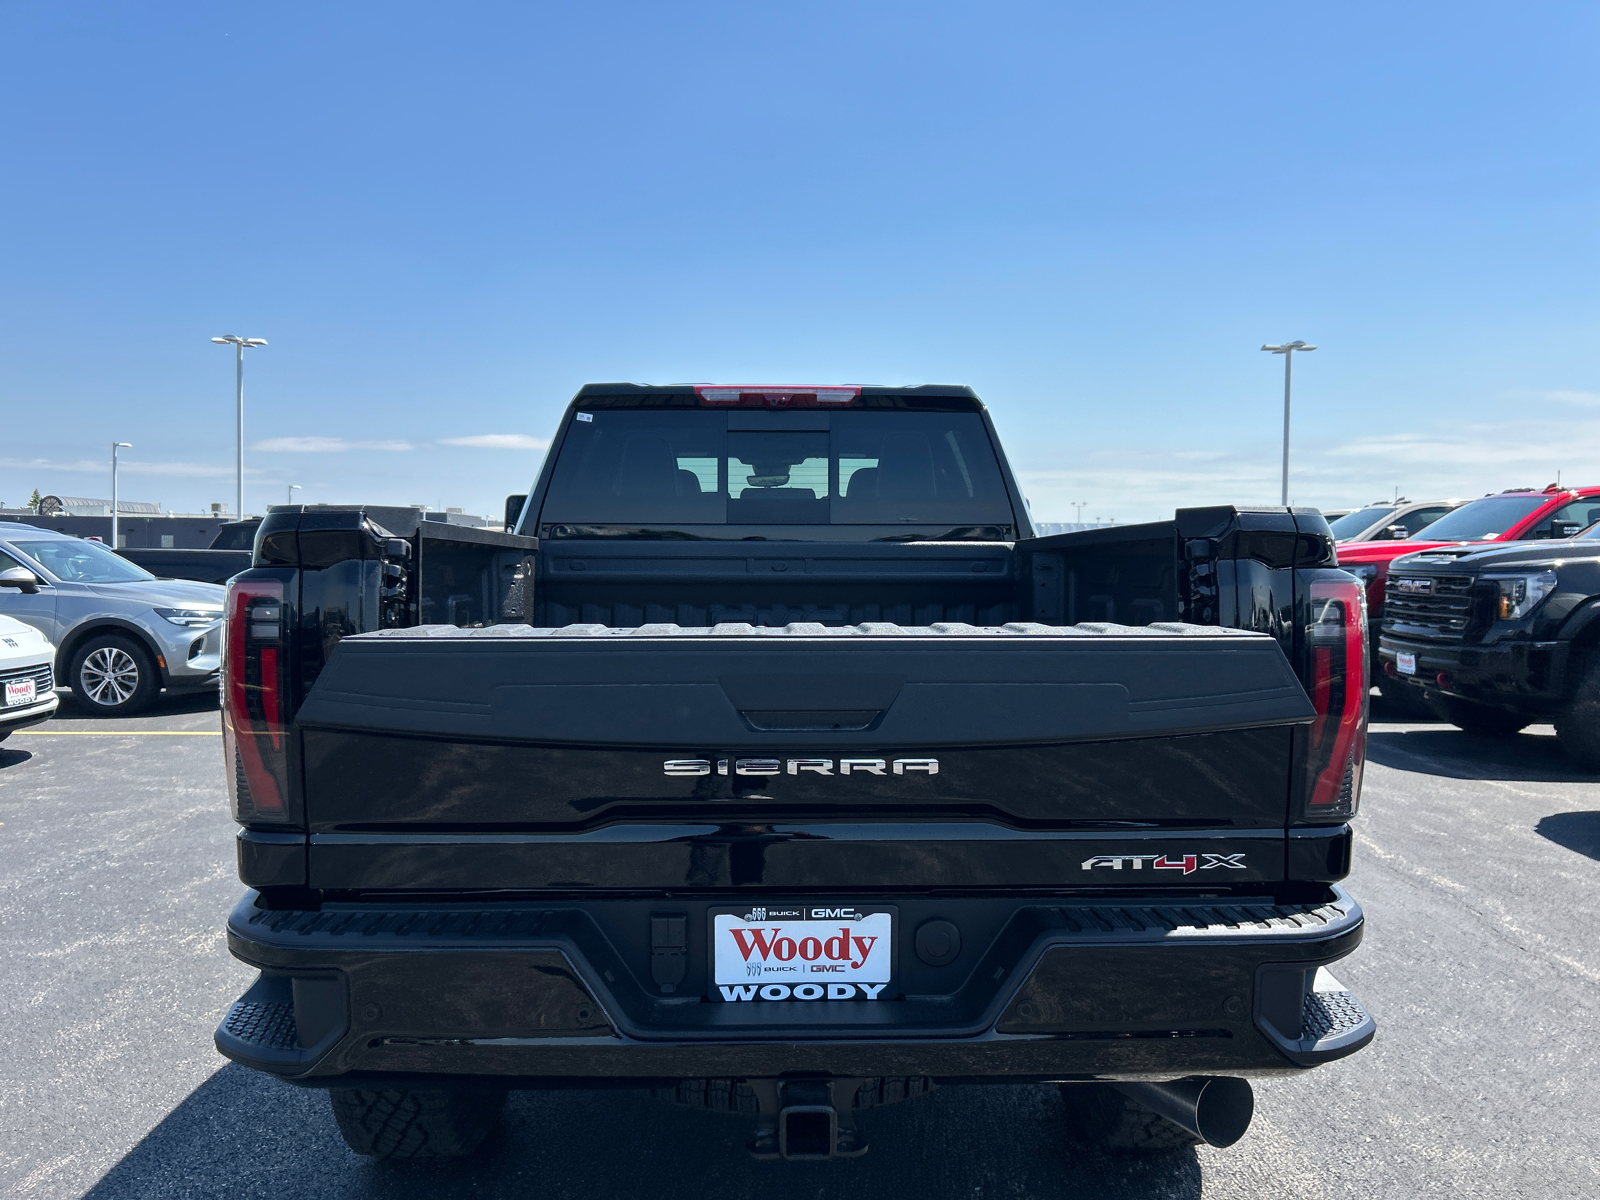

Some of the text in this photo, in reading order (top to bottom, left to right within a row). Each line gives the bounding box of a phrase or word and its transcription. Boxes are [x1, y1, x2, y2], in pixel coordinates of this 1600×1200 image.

[7, 684, 32, 695] Woody
[663, 757, 940, 777] SIERRA
[1081, 853, 1247, 876] AT4X
[811, 908, 855, 918] GMC
[729, 928, 878, 969] Woody
[810, 964, 846, 973] GMC
[718, 983, 888, 1002] WOODY
